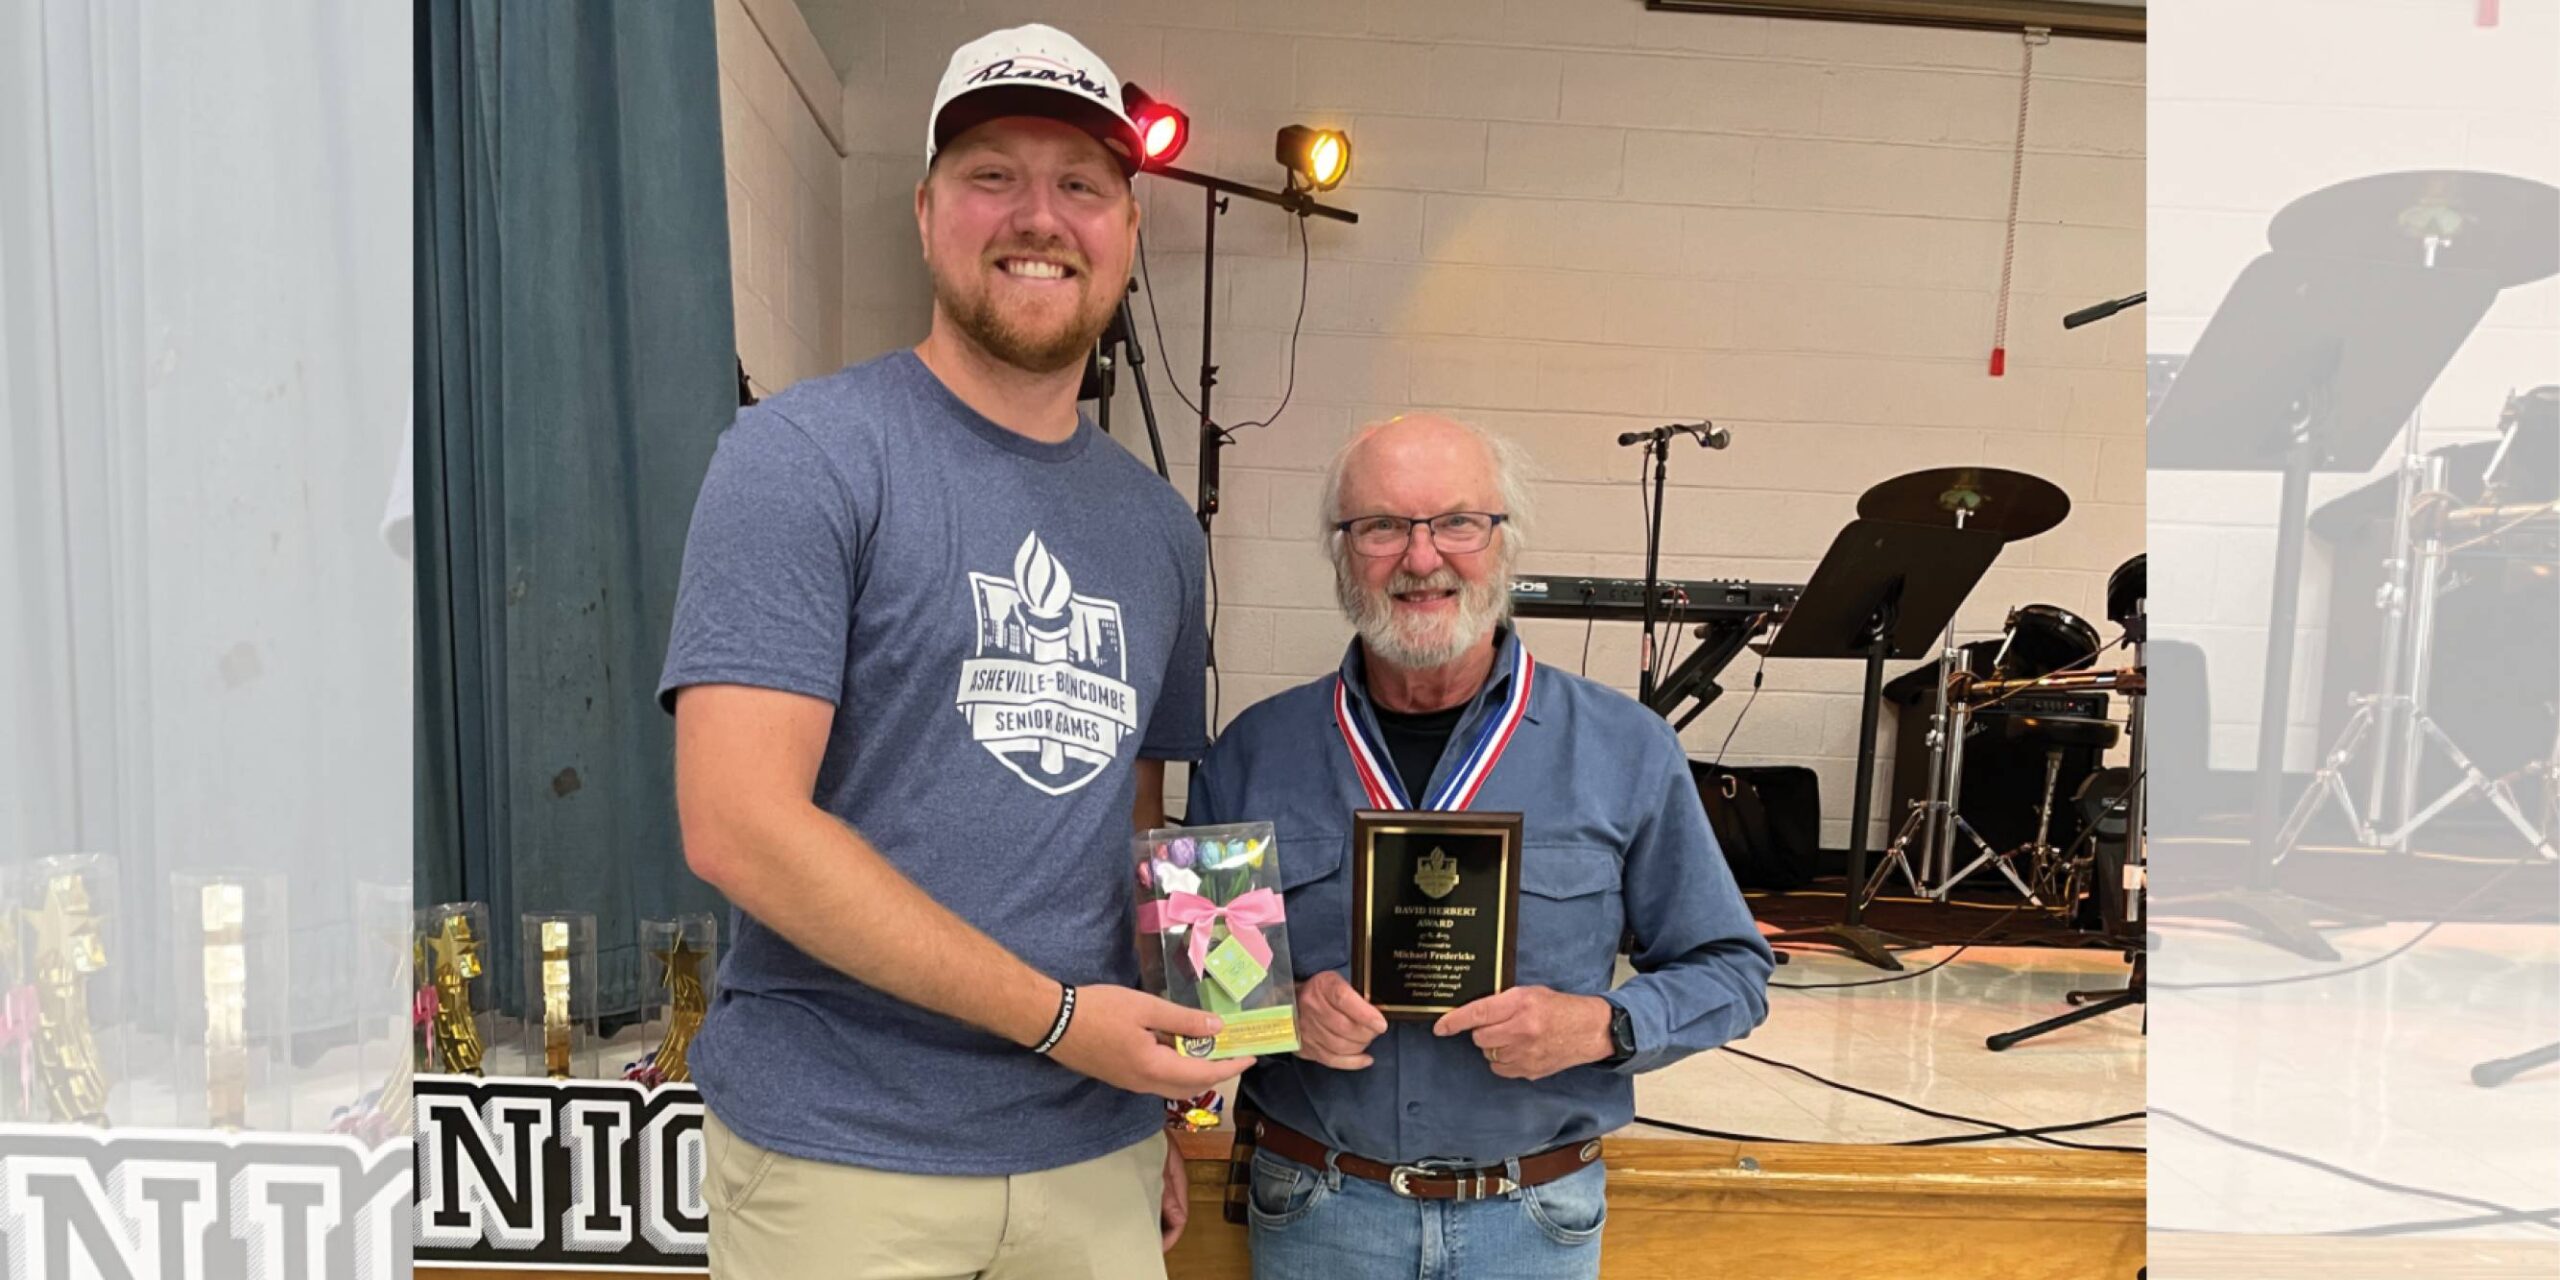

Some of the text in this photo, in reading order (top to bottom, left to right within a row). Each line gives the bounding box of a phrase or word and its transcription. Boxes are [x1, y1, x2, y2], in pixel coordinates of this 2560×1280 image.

[996, 708, 1100, 742] SENIOR GAMES
[1394, 905, 1477, 916] DAVID HERBERT
[1417, 919, 1454, 928] AWARD
[1393, 950, 1427, 959] Michael
